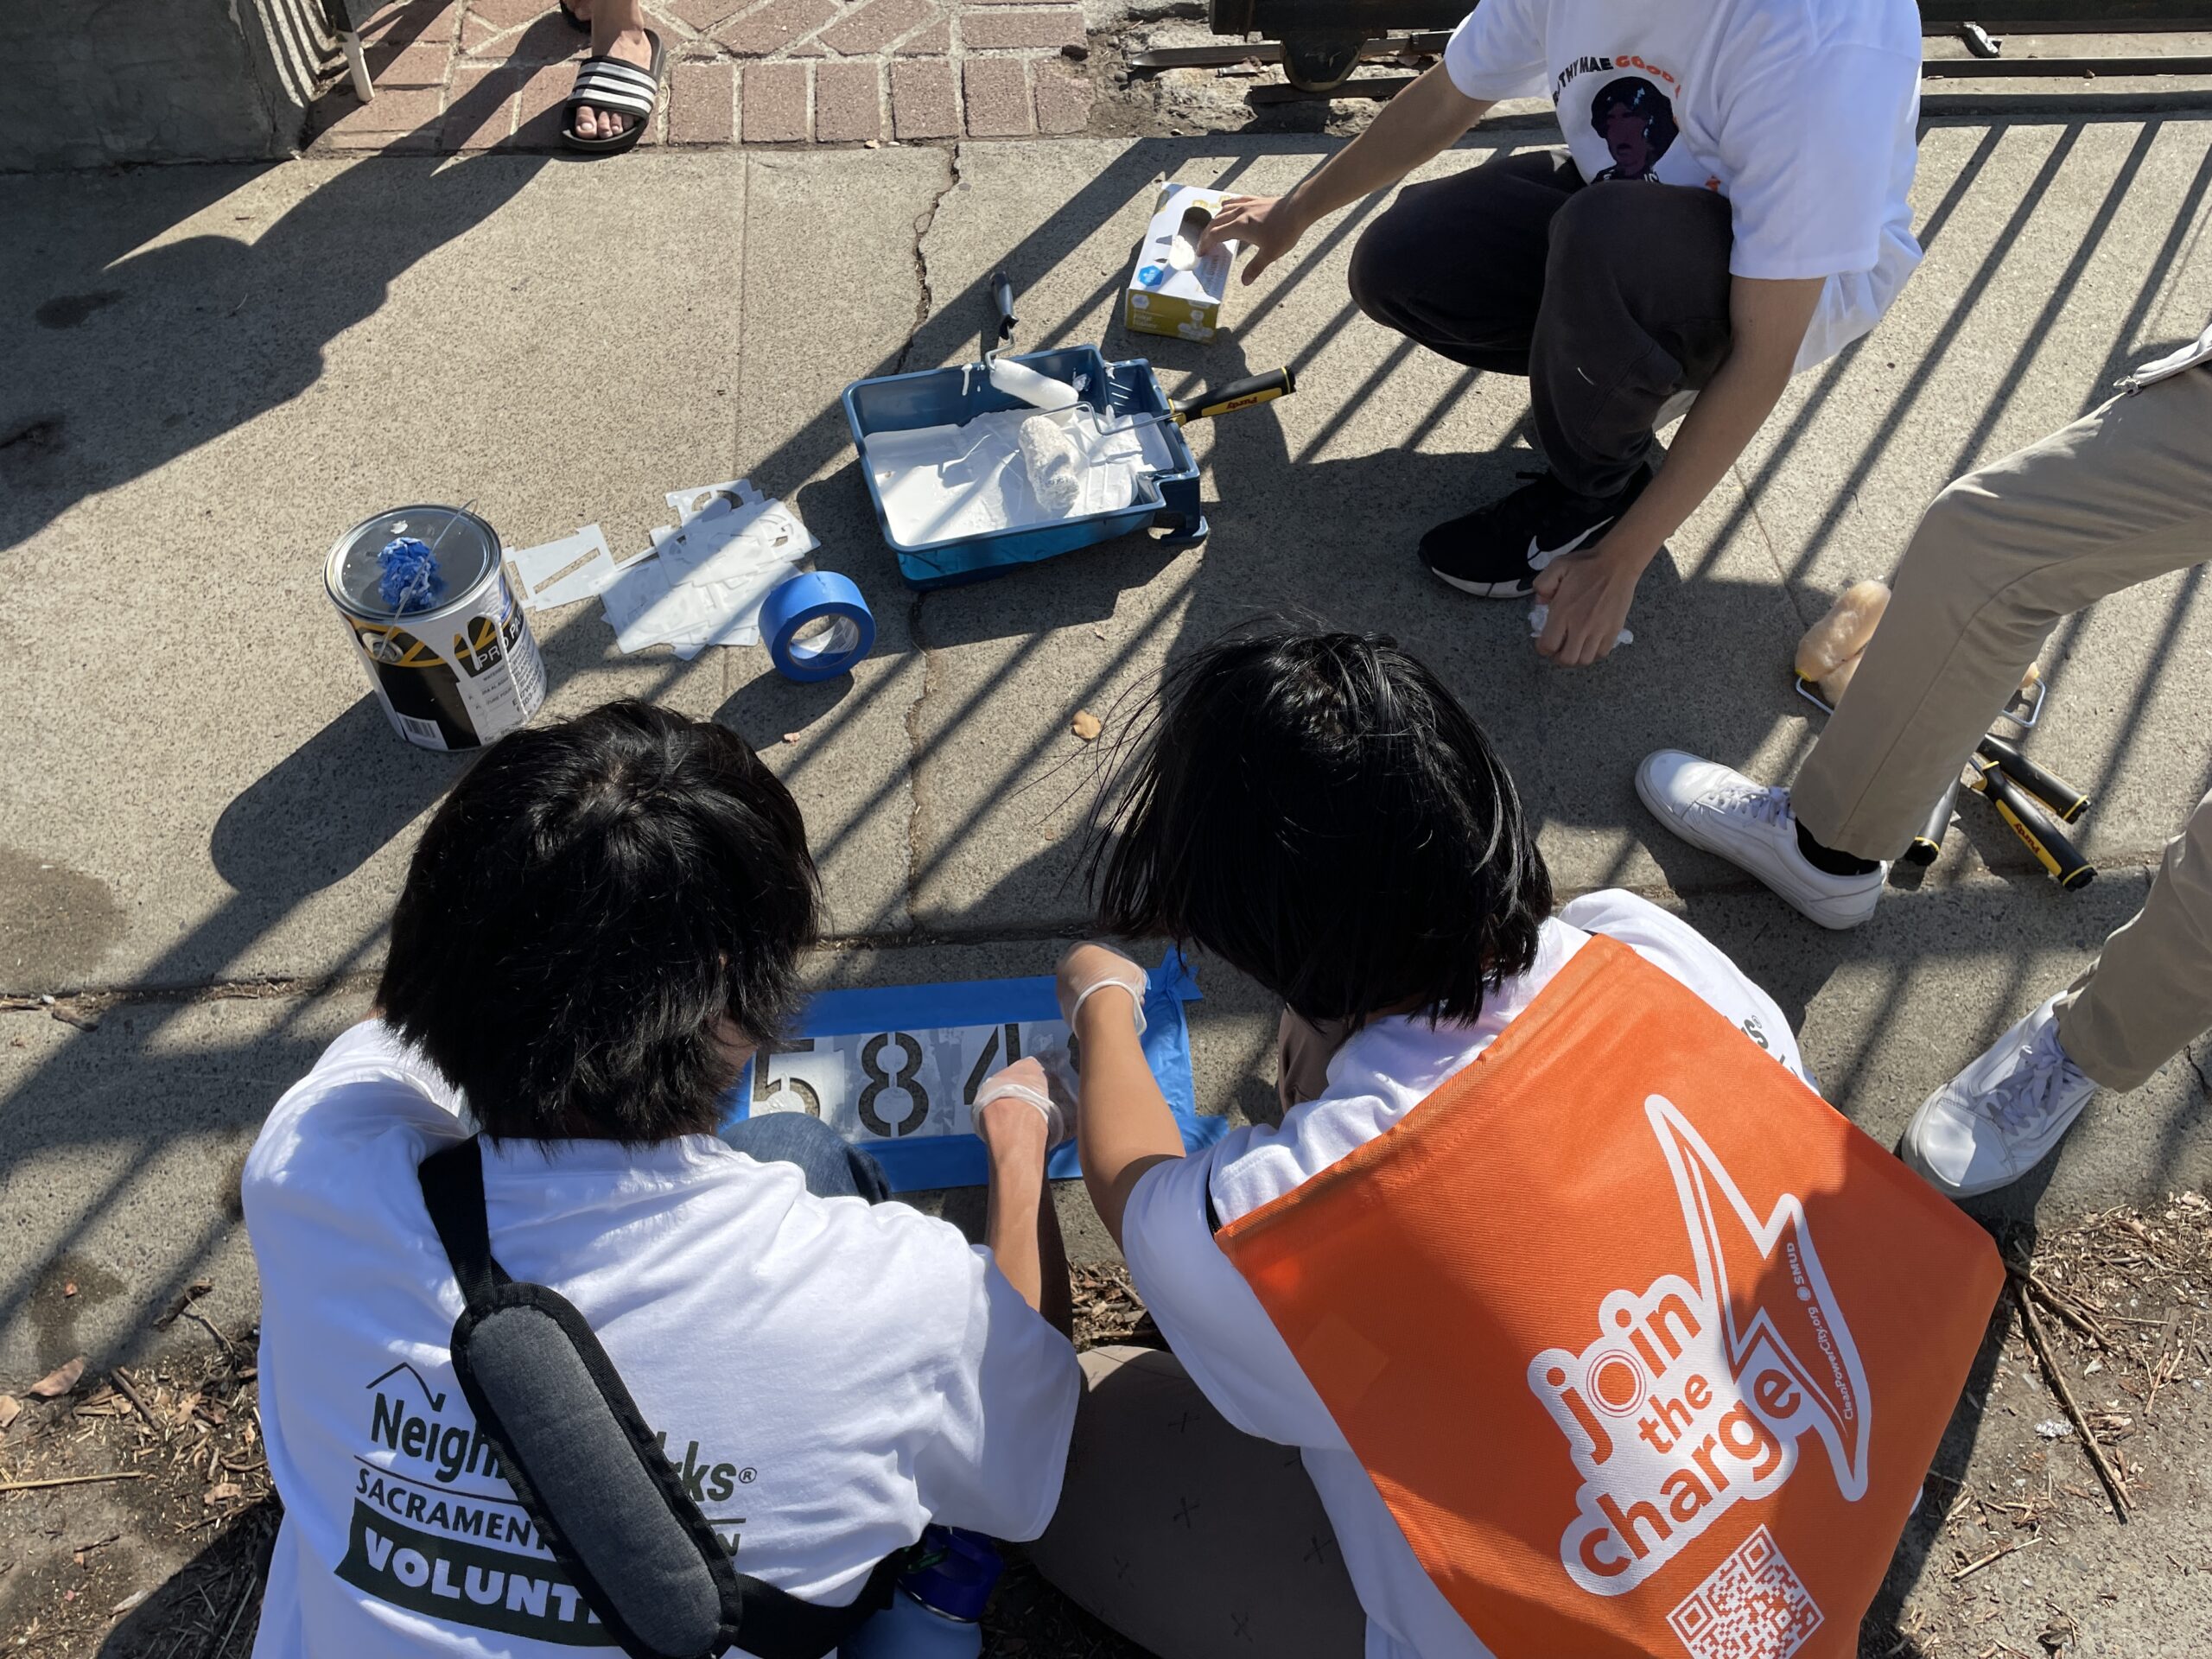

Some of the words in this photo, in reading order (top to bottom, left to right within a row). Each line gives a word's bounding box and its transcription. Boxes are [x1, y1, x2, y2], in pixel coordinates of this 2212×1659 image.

[1226, 397, 1257, 410] Purdy
[2013, 823, 2040, 854] Purdy
[1787, 1242, 1805, 1285] SMUD
[1546, 1294, 1702, 1465] join
[1808, 1306, 1853, 1421] CleanPowerCity.org
[1637, 1374, 1713, 1454] the
[1579, 1369, 1802, 1577] charge
[365, 1527, 602, 1624] VOLUNT
